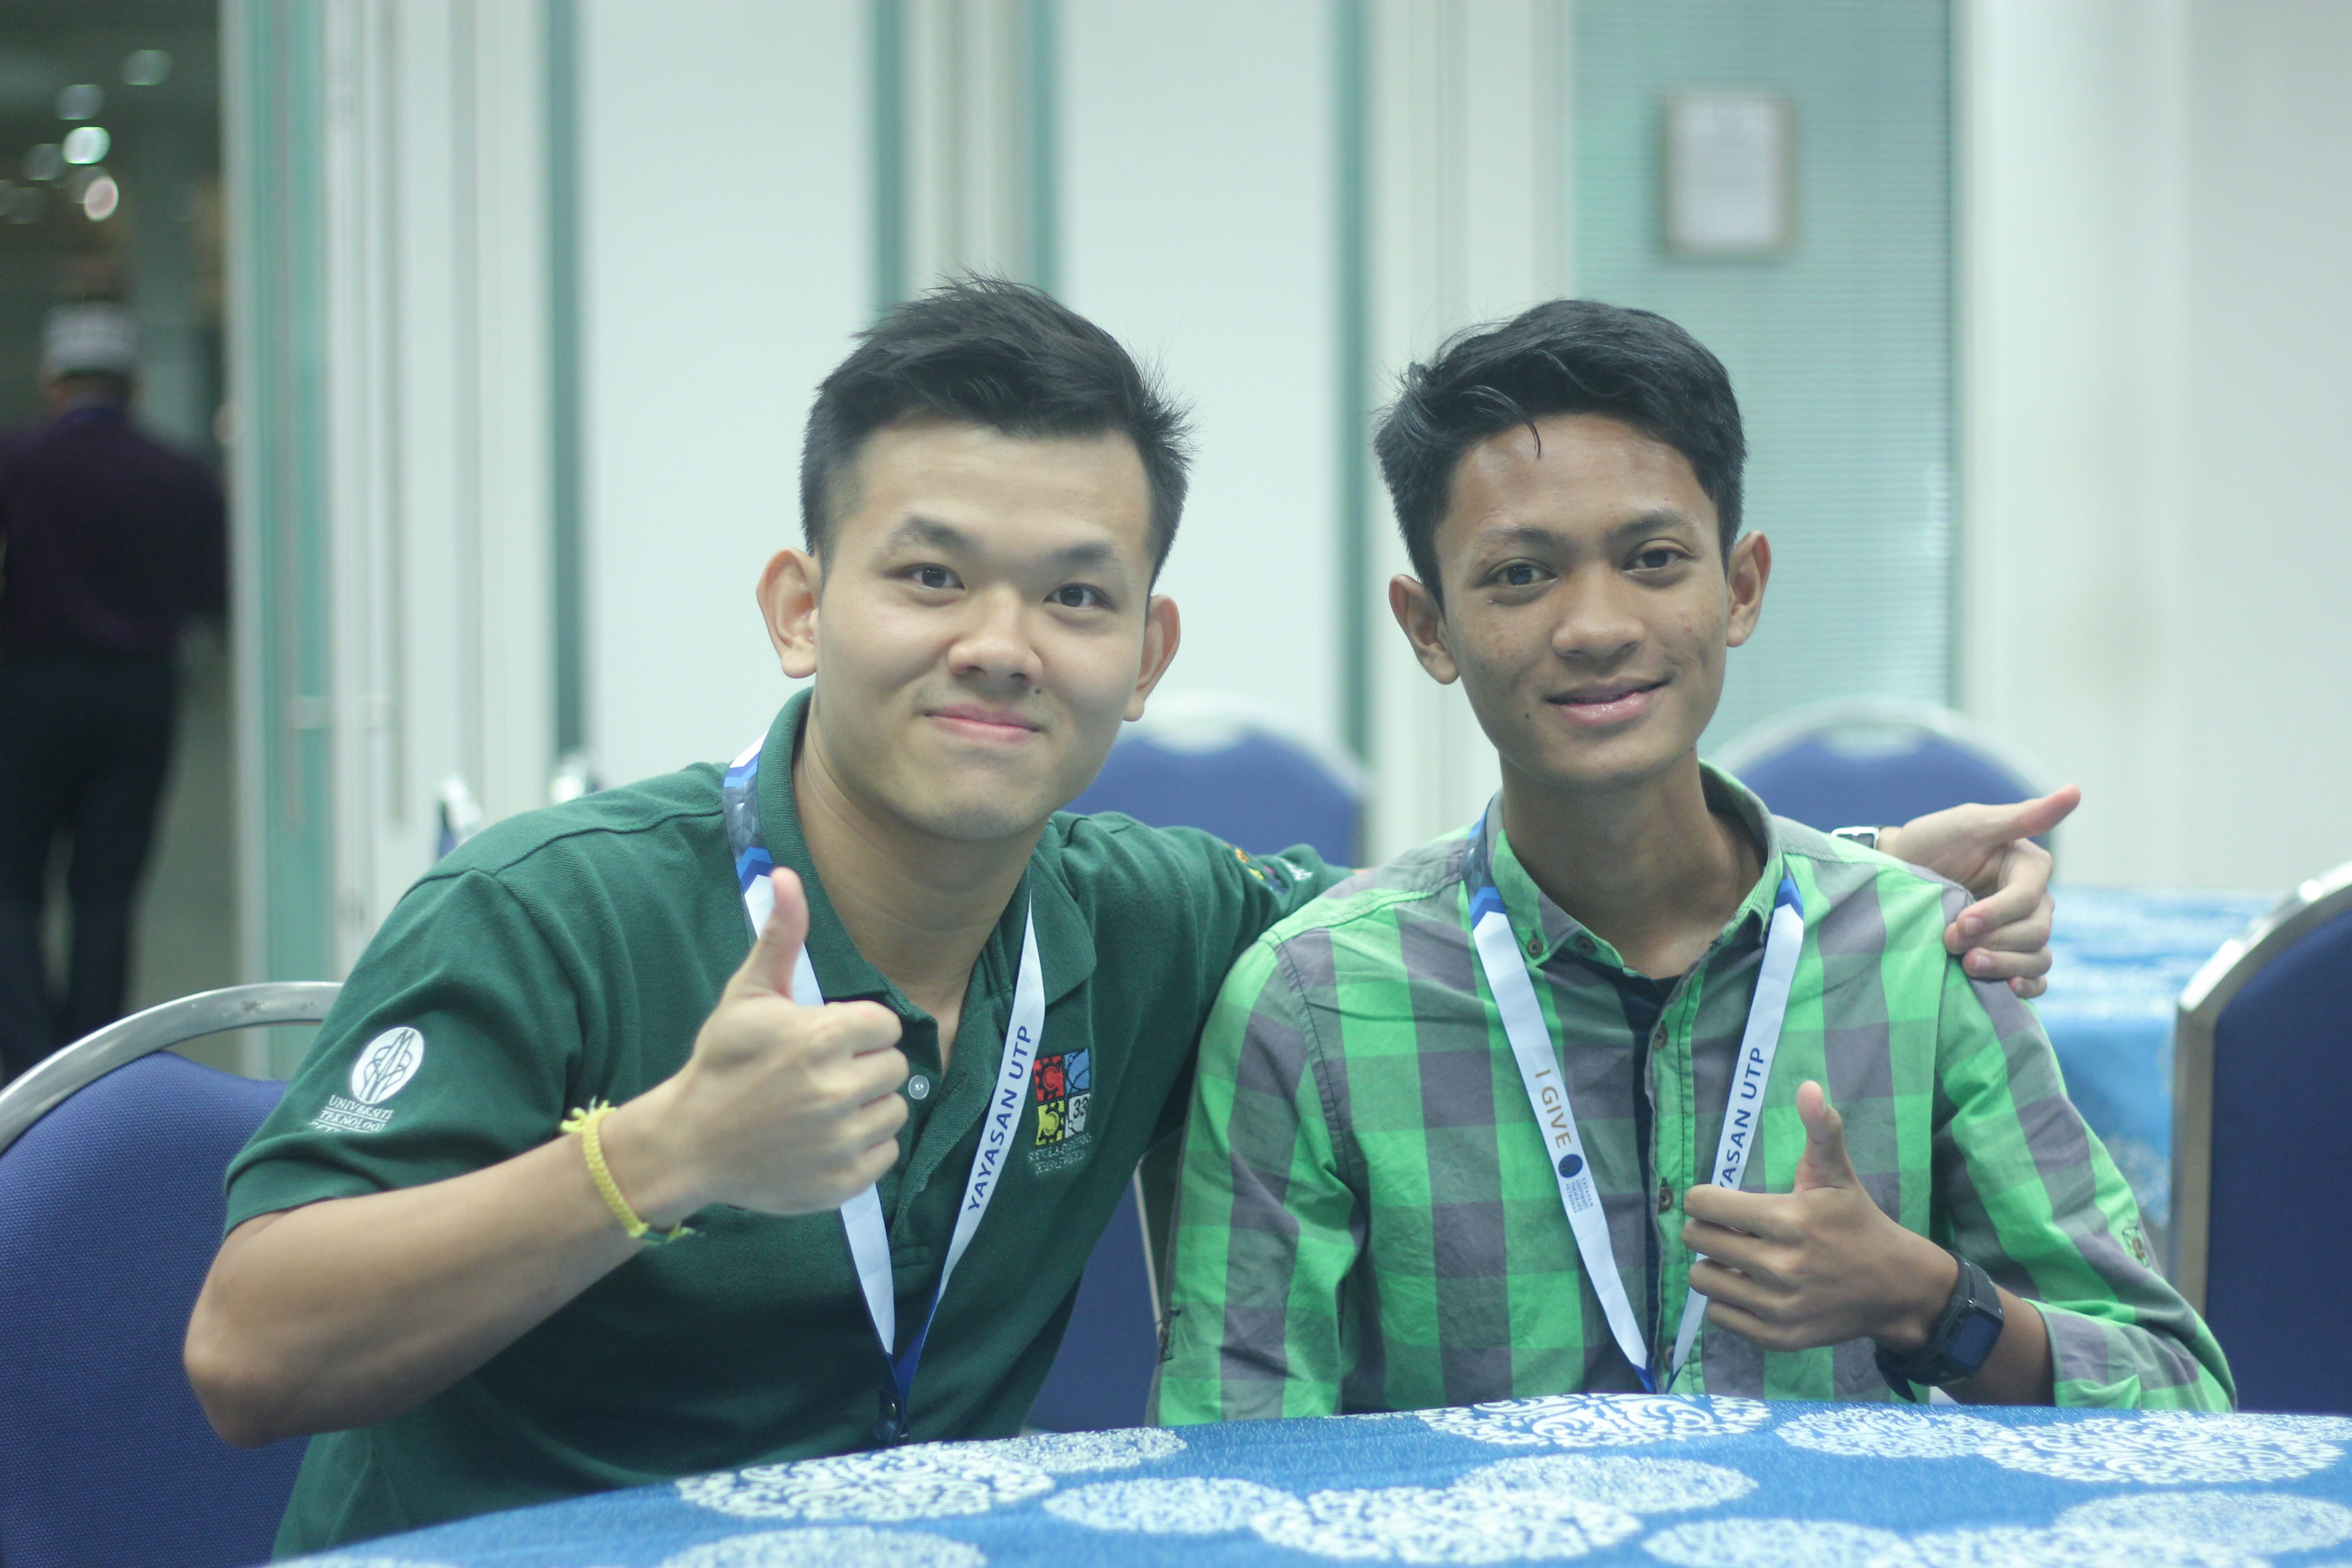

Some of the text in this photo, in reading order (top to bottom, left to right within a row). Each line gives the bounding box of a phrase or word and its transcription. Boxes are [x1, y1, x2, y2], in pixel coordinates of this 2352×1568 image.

[1741, 1047, 1764, 1100] UTP
[329, 1094, 394, 1120] UNIVERSITI
[968, 1025, 1031, 1210] YAYASAN UTP
[1535, 1069, 1572, 1149] I GIVE
